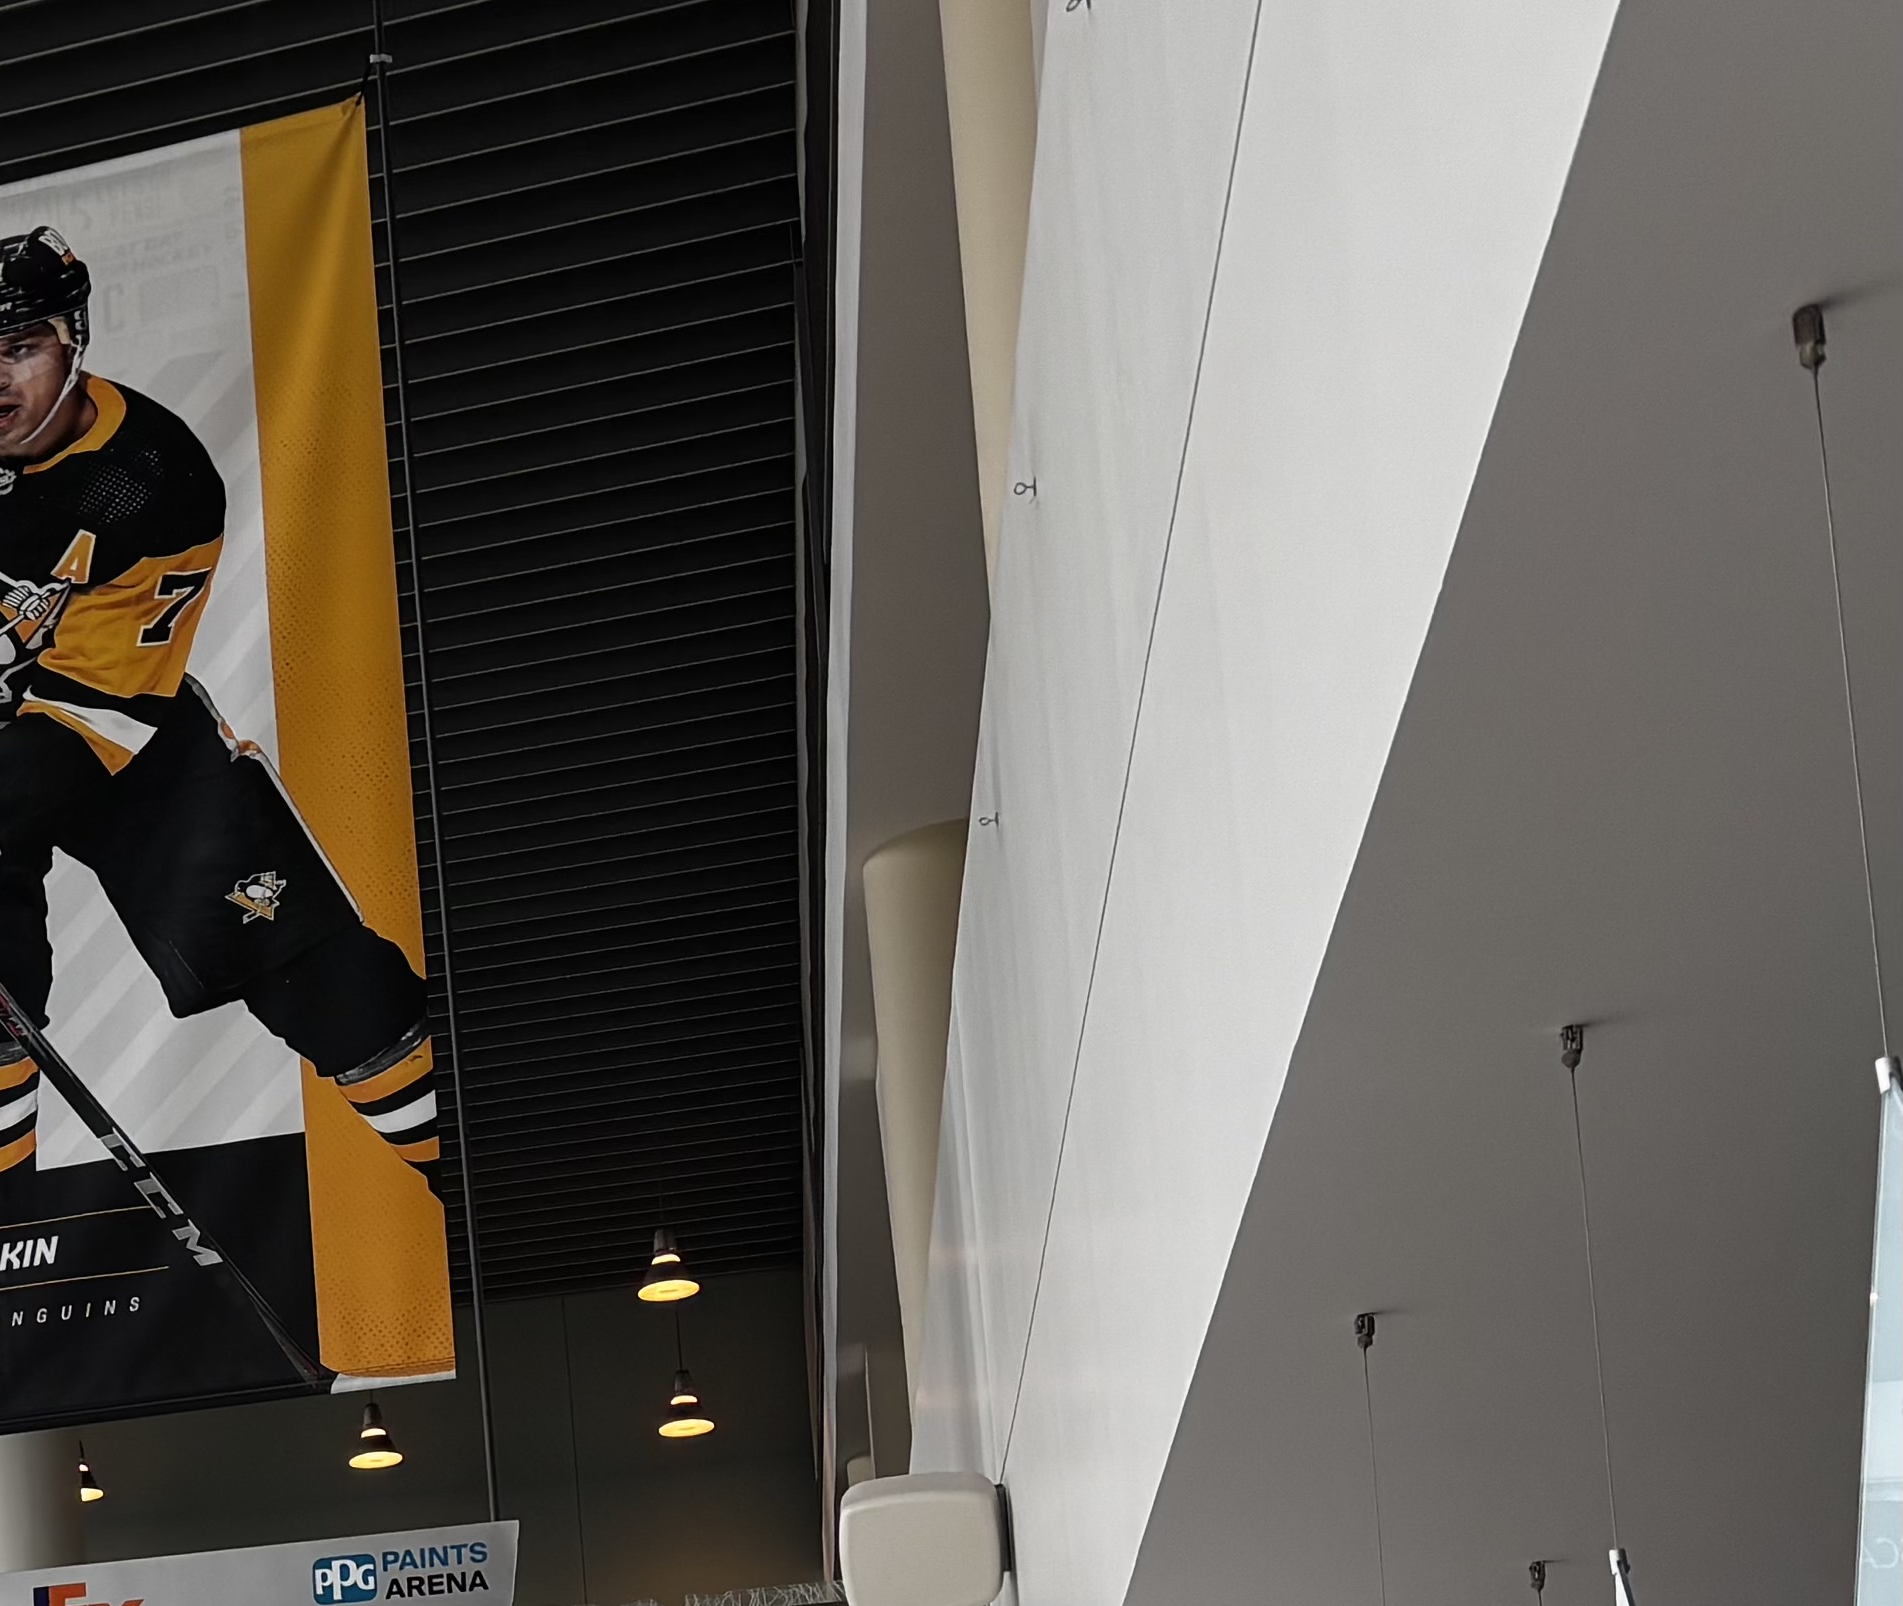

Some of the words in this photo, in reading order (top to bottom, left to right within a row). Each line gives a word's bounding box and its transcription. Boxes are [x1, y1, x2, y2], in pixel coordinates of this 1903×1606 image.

[100, 1127, 222, 1268] CCM
[315, 1558, 377, 1603] PPG
[382, 1541, 489, 1573] PAINTS
[385, 1570, 489, 1600] ARENA
